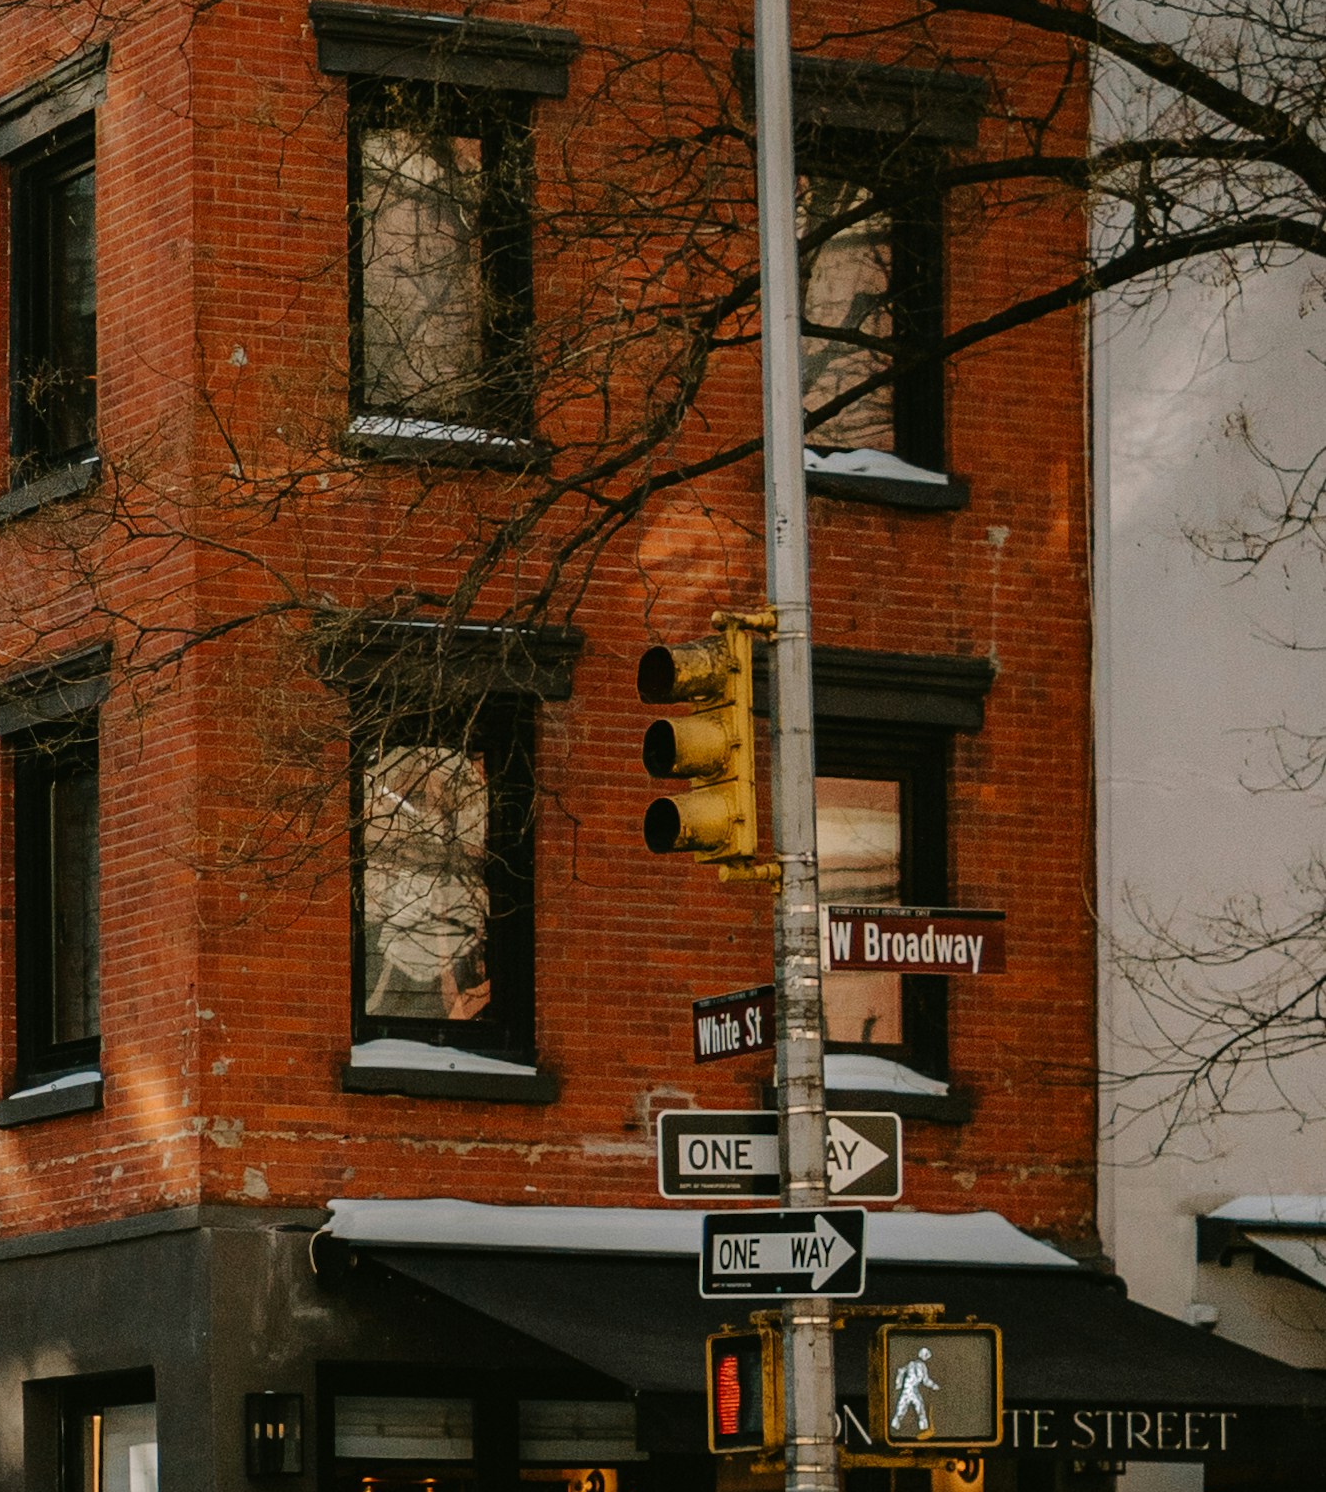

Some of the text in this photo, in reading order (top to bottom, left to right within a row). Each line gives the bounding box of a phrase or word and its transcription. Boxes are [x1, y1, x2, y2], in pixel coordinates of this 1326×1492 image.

[831, 921, 984, 974] W Broadway
[698, 1006, 763, 1056] White St
[688, 1139, 860, 1171] ONE AY
[719, 1236, 836, 1270] ONE WAY
[1072, 1409, 1237, 1451] STREET
